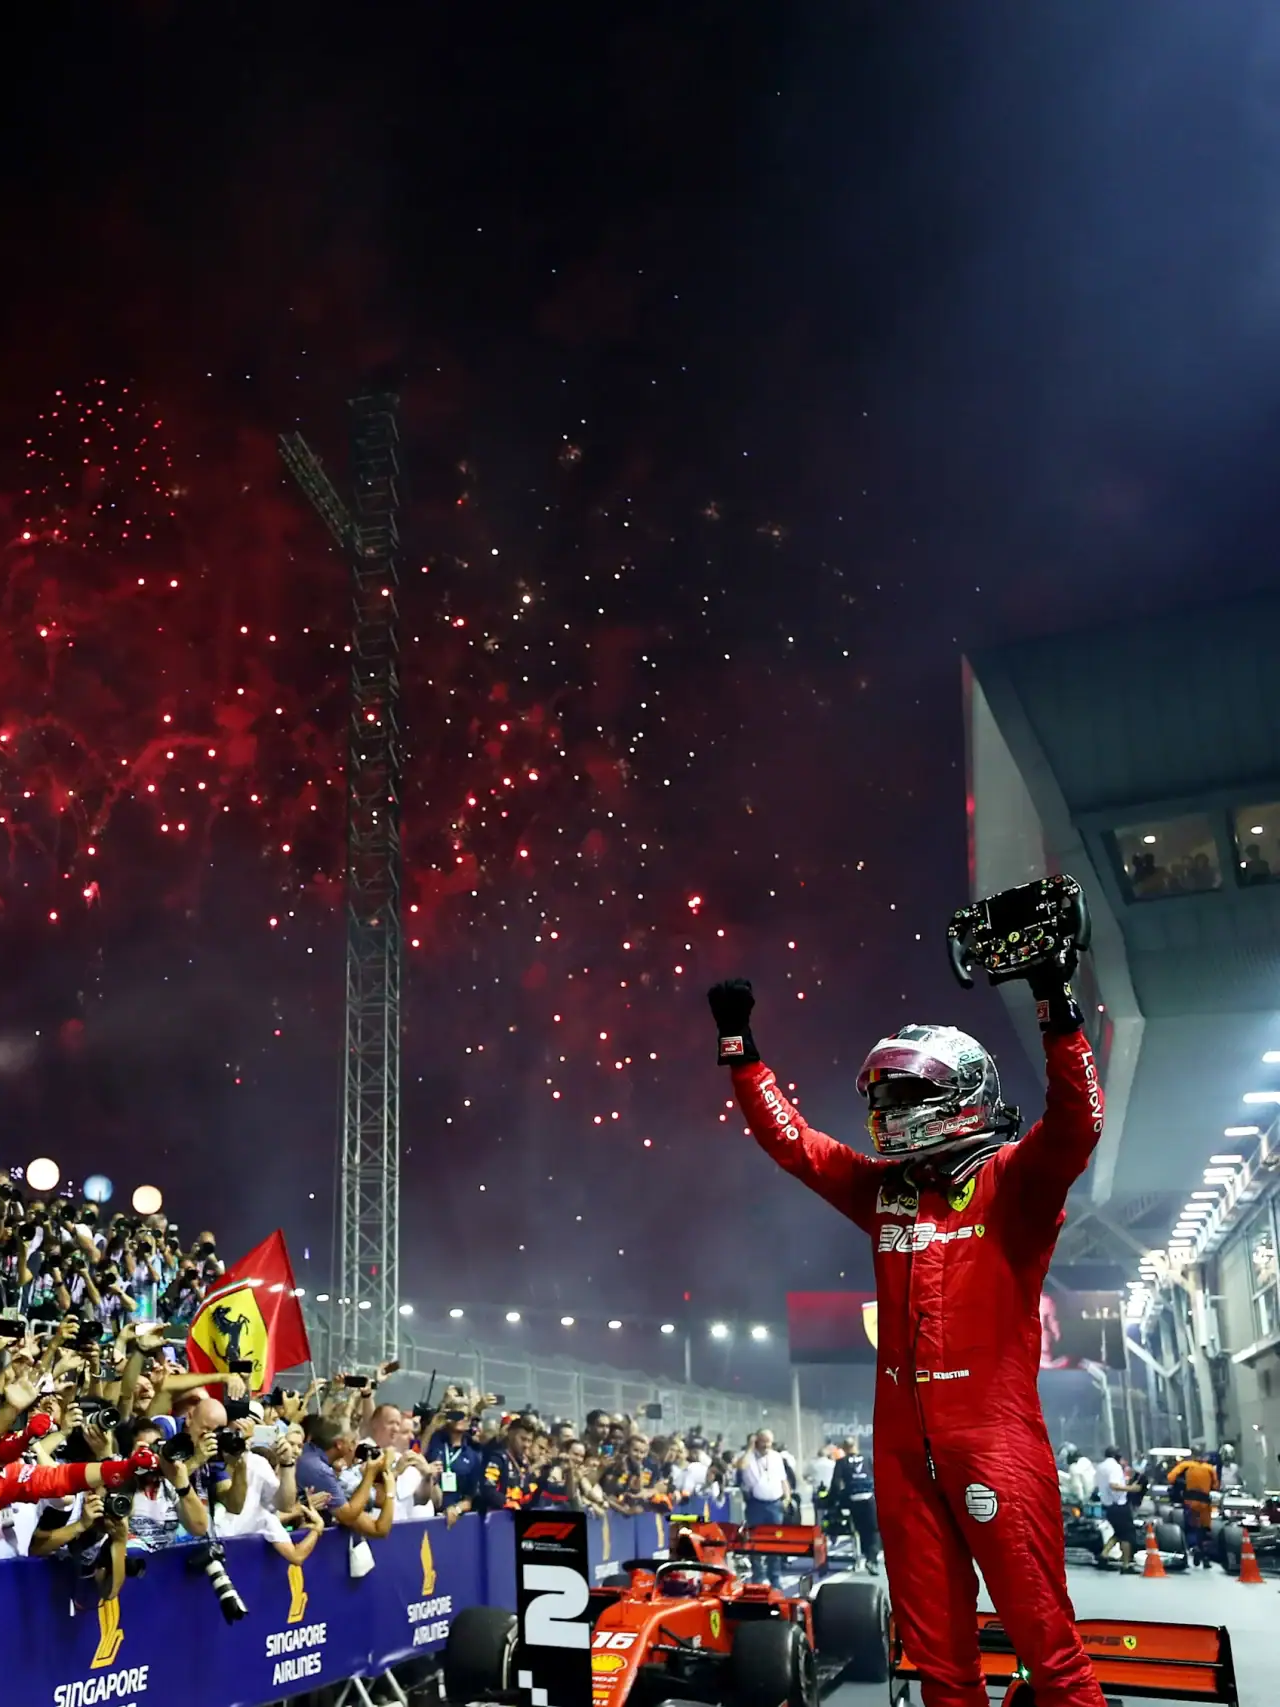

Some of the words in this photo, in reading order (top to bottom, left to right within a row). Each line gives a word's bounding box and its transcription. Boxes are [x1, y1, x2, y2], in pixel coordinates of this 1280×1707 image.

[1081, 1051, 1104, 1133] Lenovo
[965, 1490, 996, 1517] 5
[522, 1522, 577, 1540] F1
[407, 1595, 452, 1624] SINGAPORE
[523, 1564, 591, 1650] 2
[265, 1622, 327, 1657] SINGAPORE
[413, 1619, 450, 1647] AIRLINES
[592, 1631, 639, 1649] 16
[272, 1651, 322, 1686] AIRLINES
[54, 1665, 149, 1707] SINGAPORE
